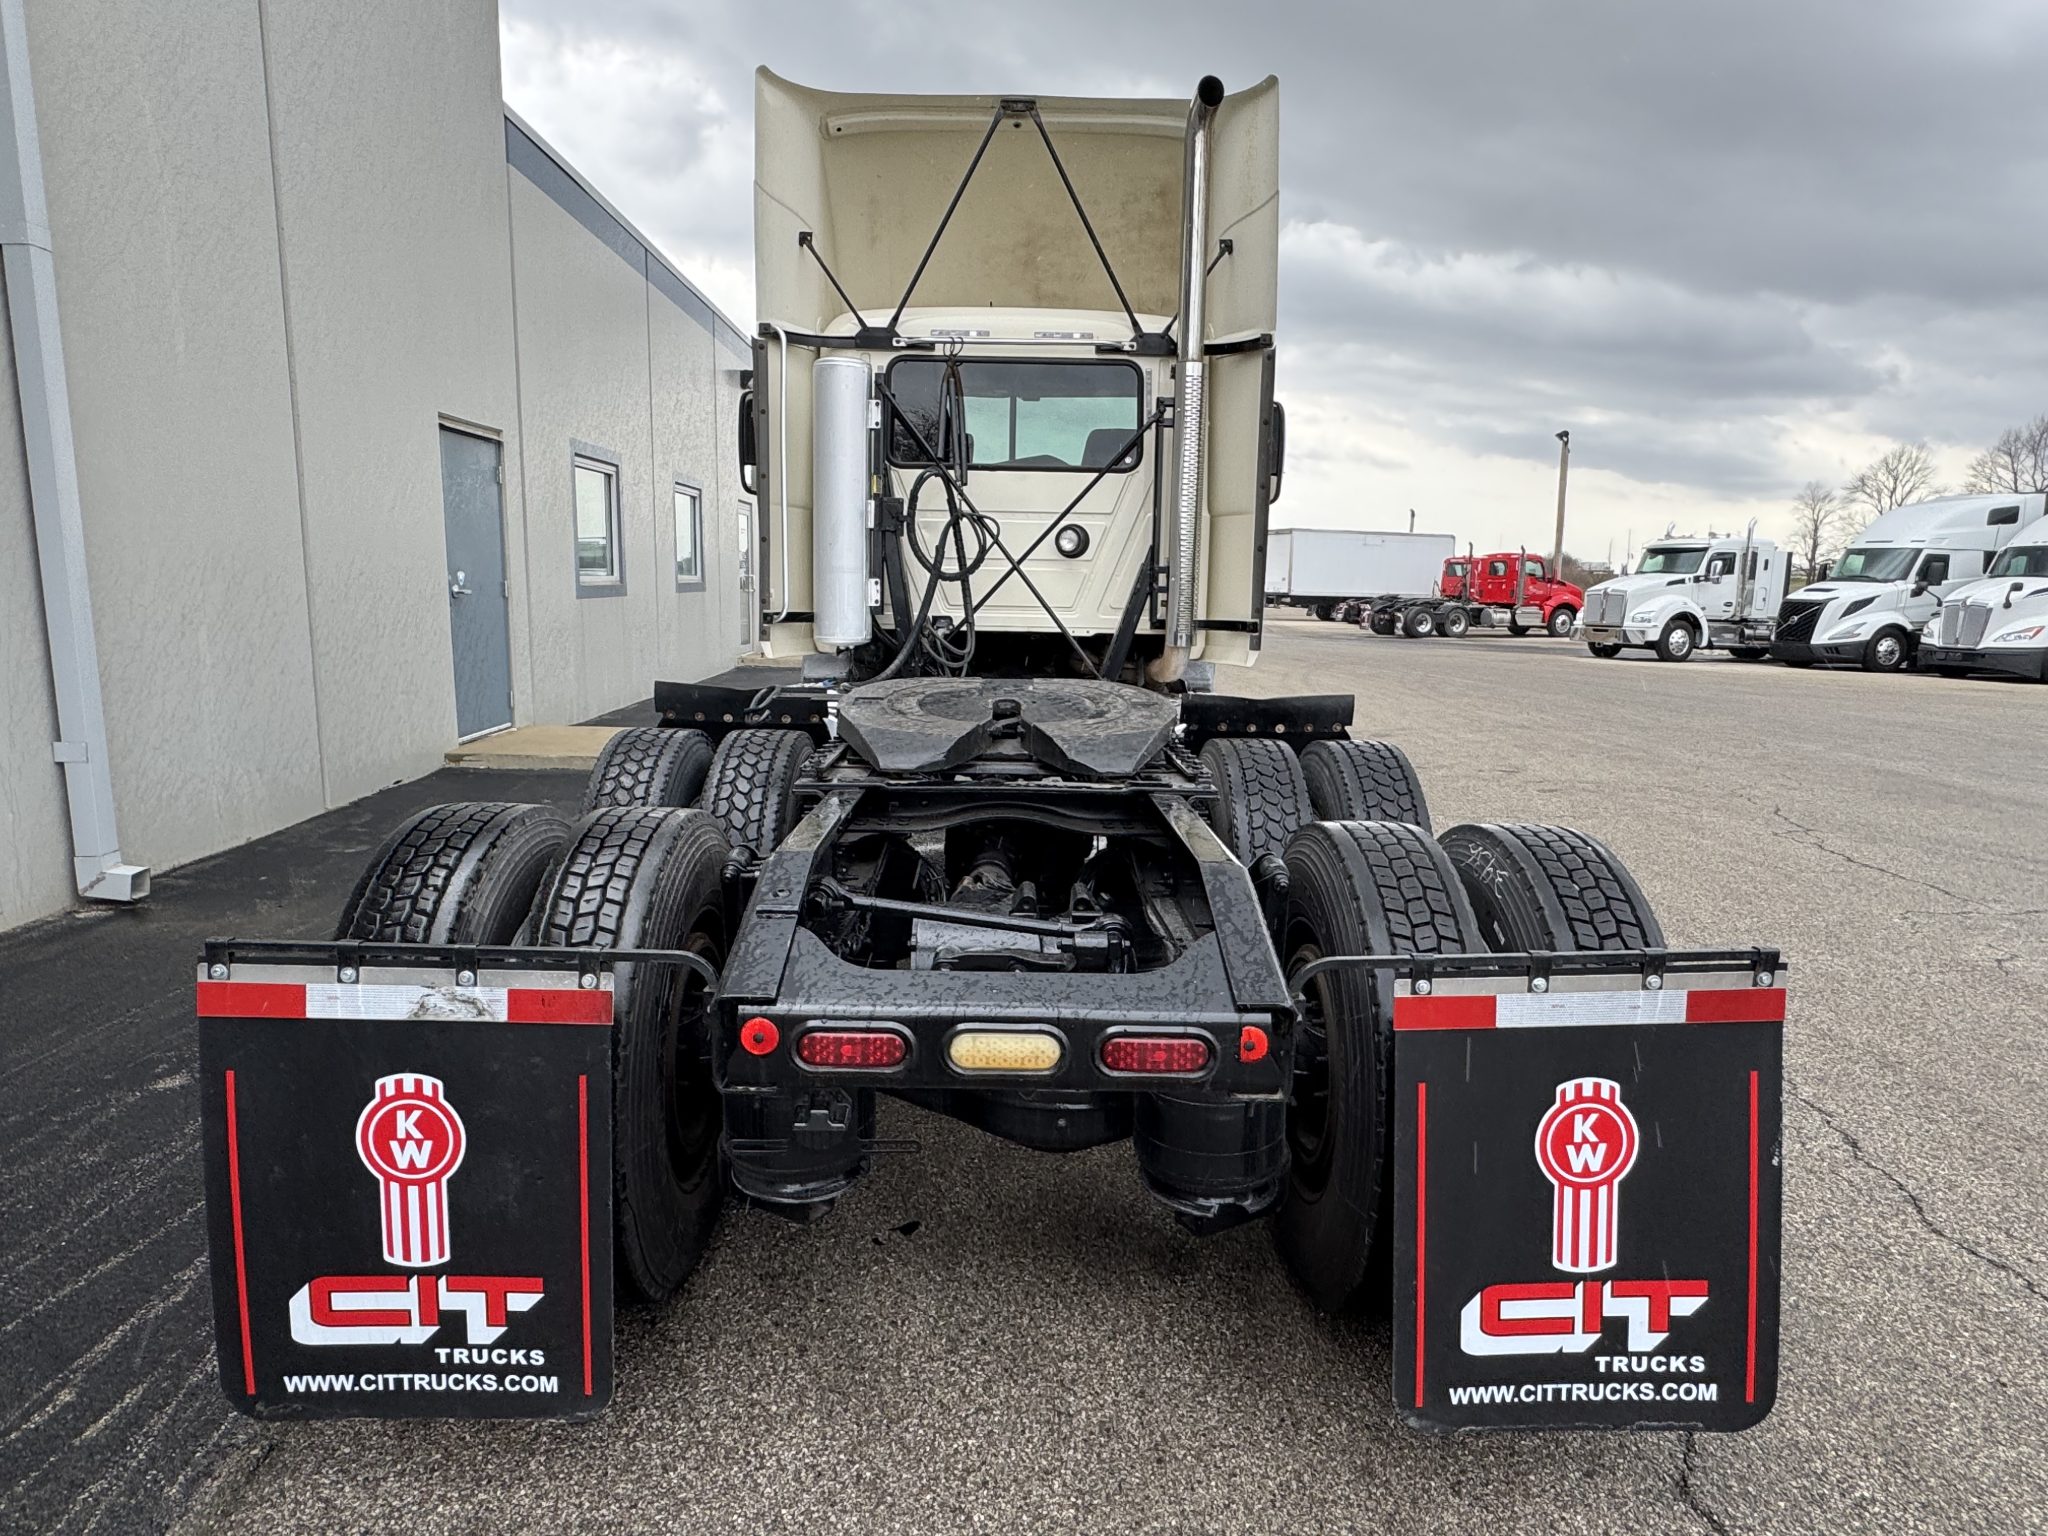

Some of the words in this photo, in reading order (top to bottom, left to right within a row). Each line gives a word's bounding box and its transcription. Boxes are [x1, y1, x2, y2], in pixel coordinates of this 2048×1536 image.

[397, 1110, 424, 1139] K
[1573, 1114, 1600, 1142] K
[389, 1141, 432, 1170] W
[1565, 1144, 1608, 1174] W
[288, 1274, 545, 1346] CIT
[1460, 1279, 1710, 1356] CIT
[434, 1347, 545, 1366] TRUCKS
[1594, 1355, 1706, 1373] TRUCKS
[283, 1373, 559, 1394] WWW.CITTRUCKS.COM
[1448, 1382, 1718, 1406] WWW.CITTRUCKS.COM
